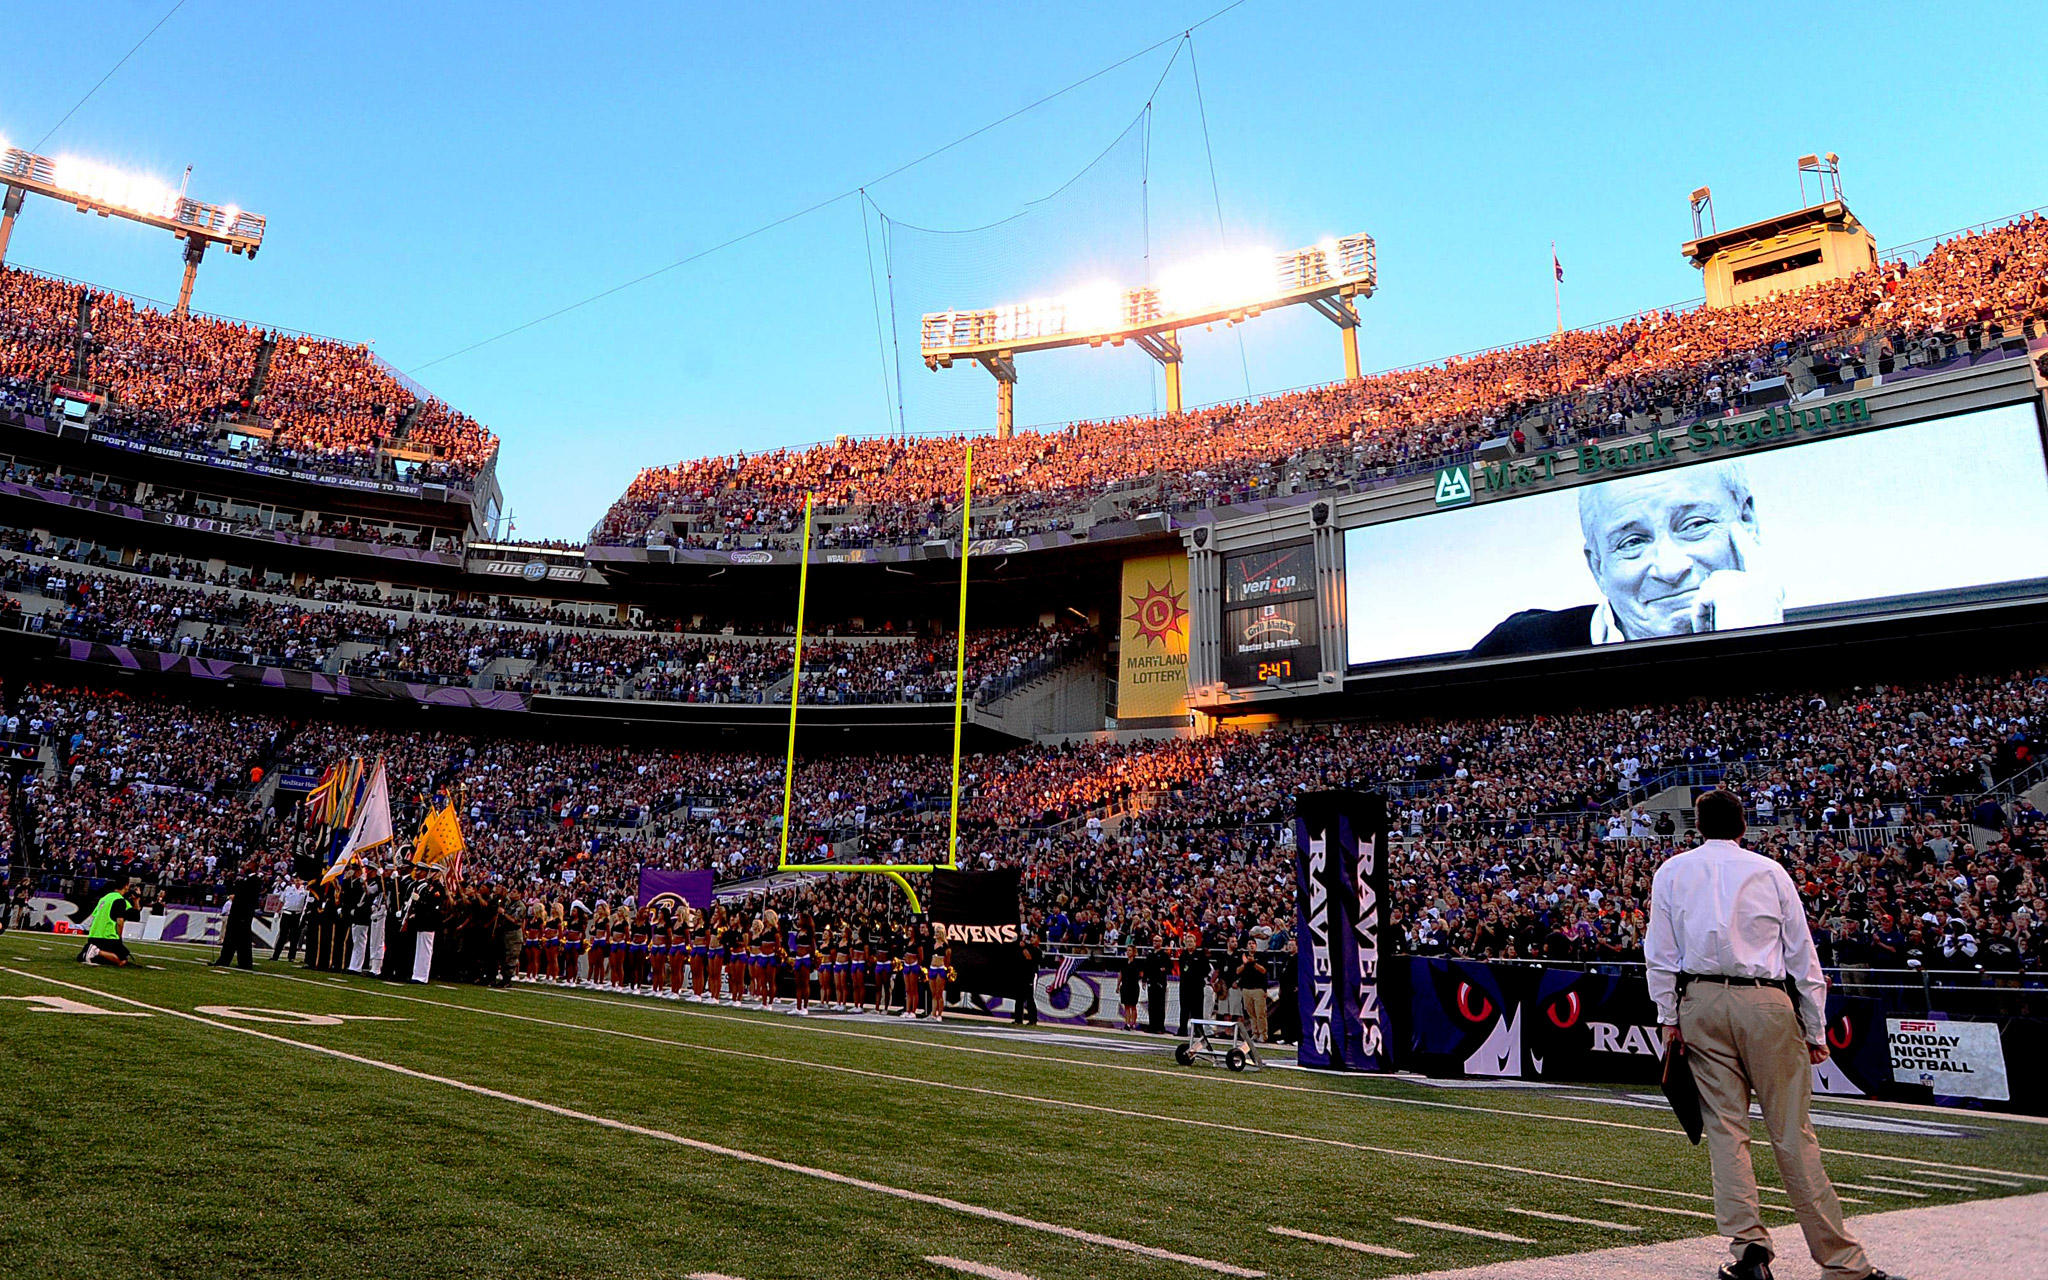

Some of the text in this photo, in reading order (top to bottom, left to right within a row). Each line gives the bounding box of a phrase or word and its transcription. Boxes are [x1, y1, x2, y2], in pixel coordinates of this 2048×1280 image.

[1482, 397, 1872, 494] M&T Bank Stadium
[91, 433, 418, 494] REPORT FAN ISSUES! TEXT "RAVENS" <SPACE> ISSUE AND LOCATION TO 78247
[164, 513, 232, 534] SMYTH
[486, 563, 523, 575] FLITE
[548, 567, 582, 579] DECK
[1242, 575, 1297, 595] verizon
[1247, 622, 1265, 637] Grill
[1264, 641, 1276, 649] the
[1127, 653, 1187, 669] MARYLAND
[1133, 670, 1182, 684] LOTTERY
[1258, 660, 1291, 682] 2:47
[1308, 828, 1333, 1056] RAVENS
[1355, 832, 1383, 1056] RAVENS
[1900, 1021, 1936, 1032] ESPN
[1585, 1021, 1666, 1062] RAV
[1893, 1046, 1951, 1059] NIGHT
[1890, 1057, 1974, 1074] OOTBALL
